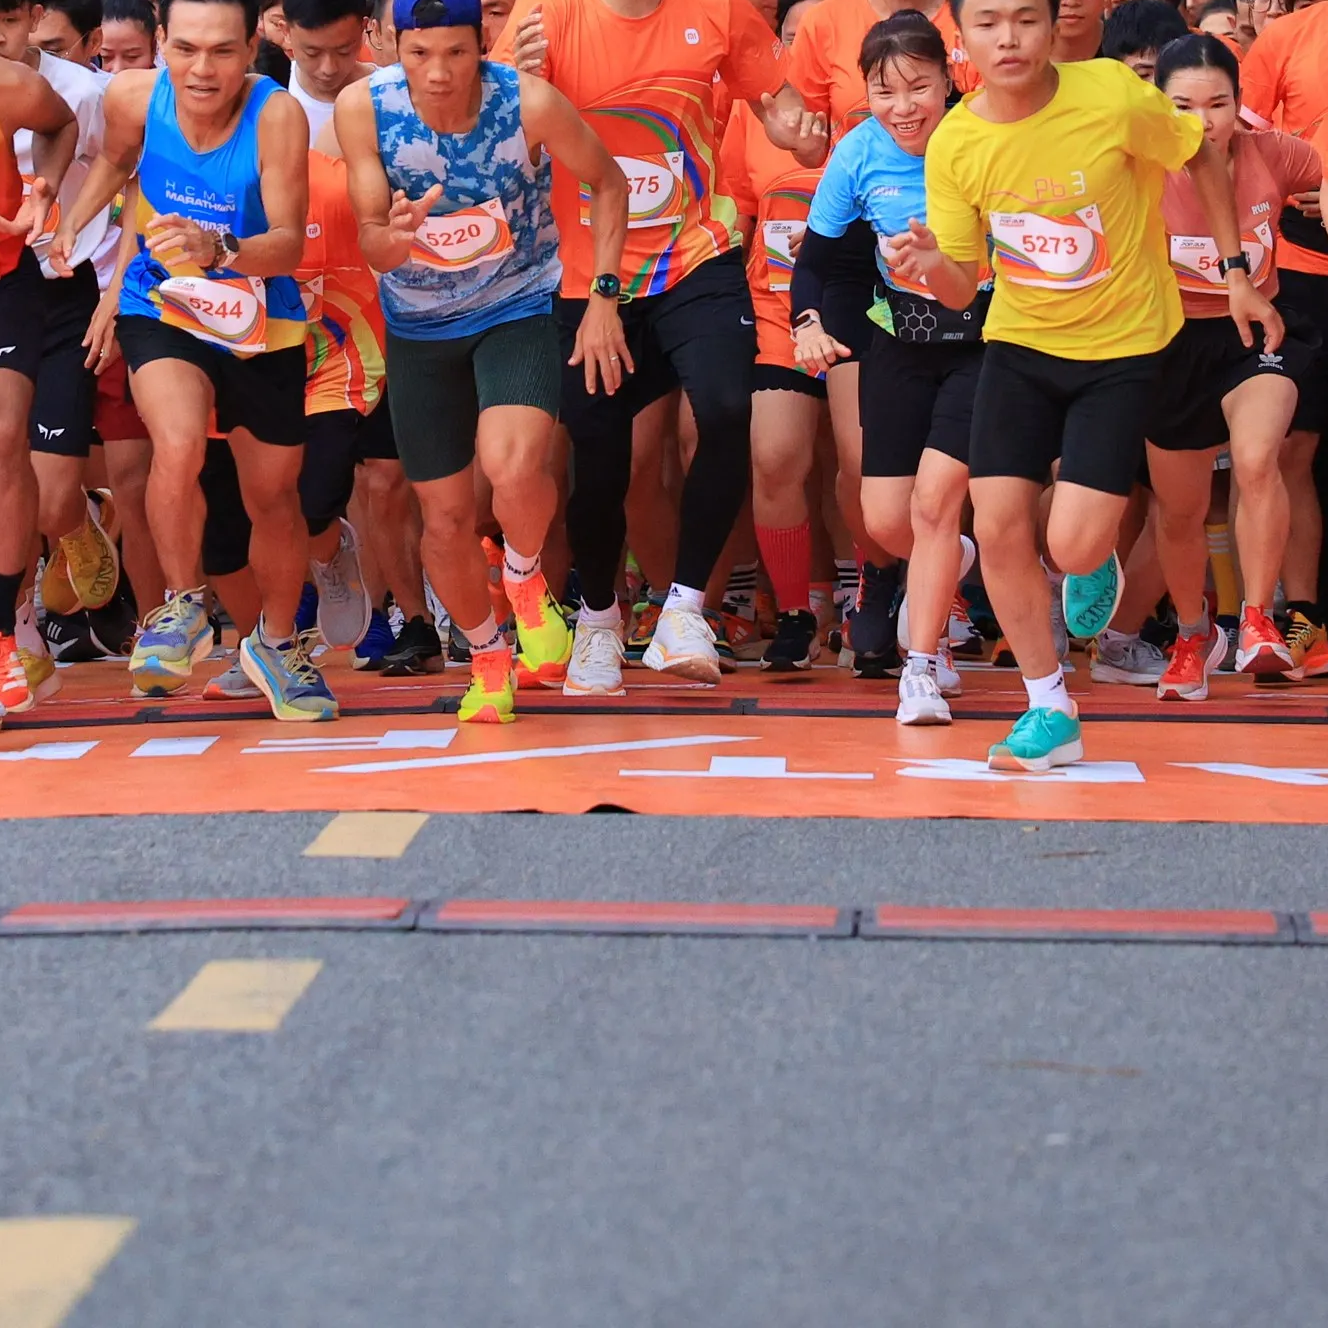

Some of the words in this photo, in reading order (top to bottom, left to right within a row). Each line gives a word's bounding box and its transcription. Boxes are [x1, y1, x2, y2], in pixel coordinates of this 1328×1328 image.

[1251, 201, 1270, 216] RUN
[426, 223, 481, 247] 5220
[1022, 234, 1078, 255] 5273
[189, 297, 243, 319] 5244
